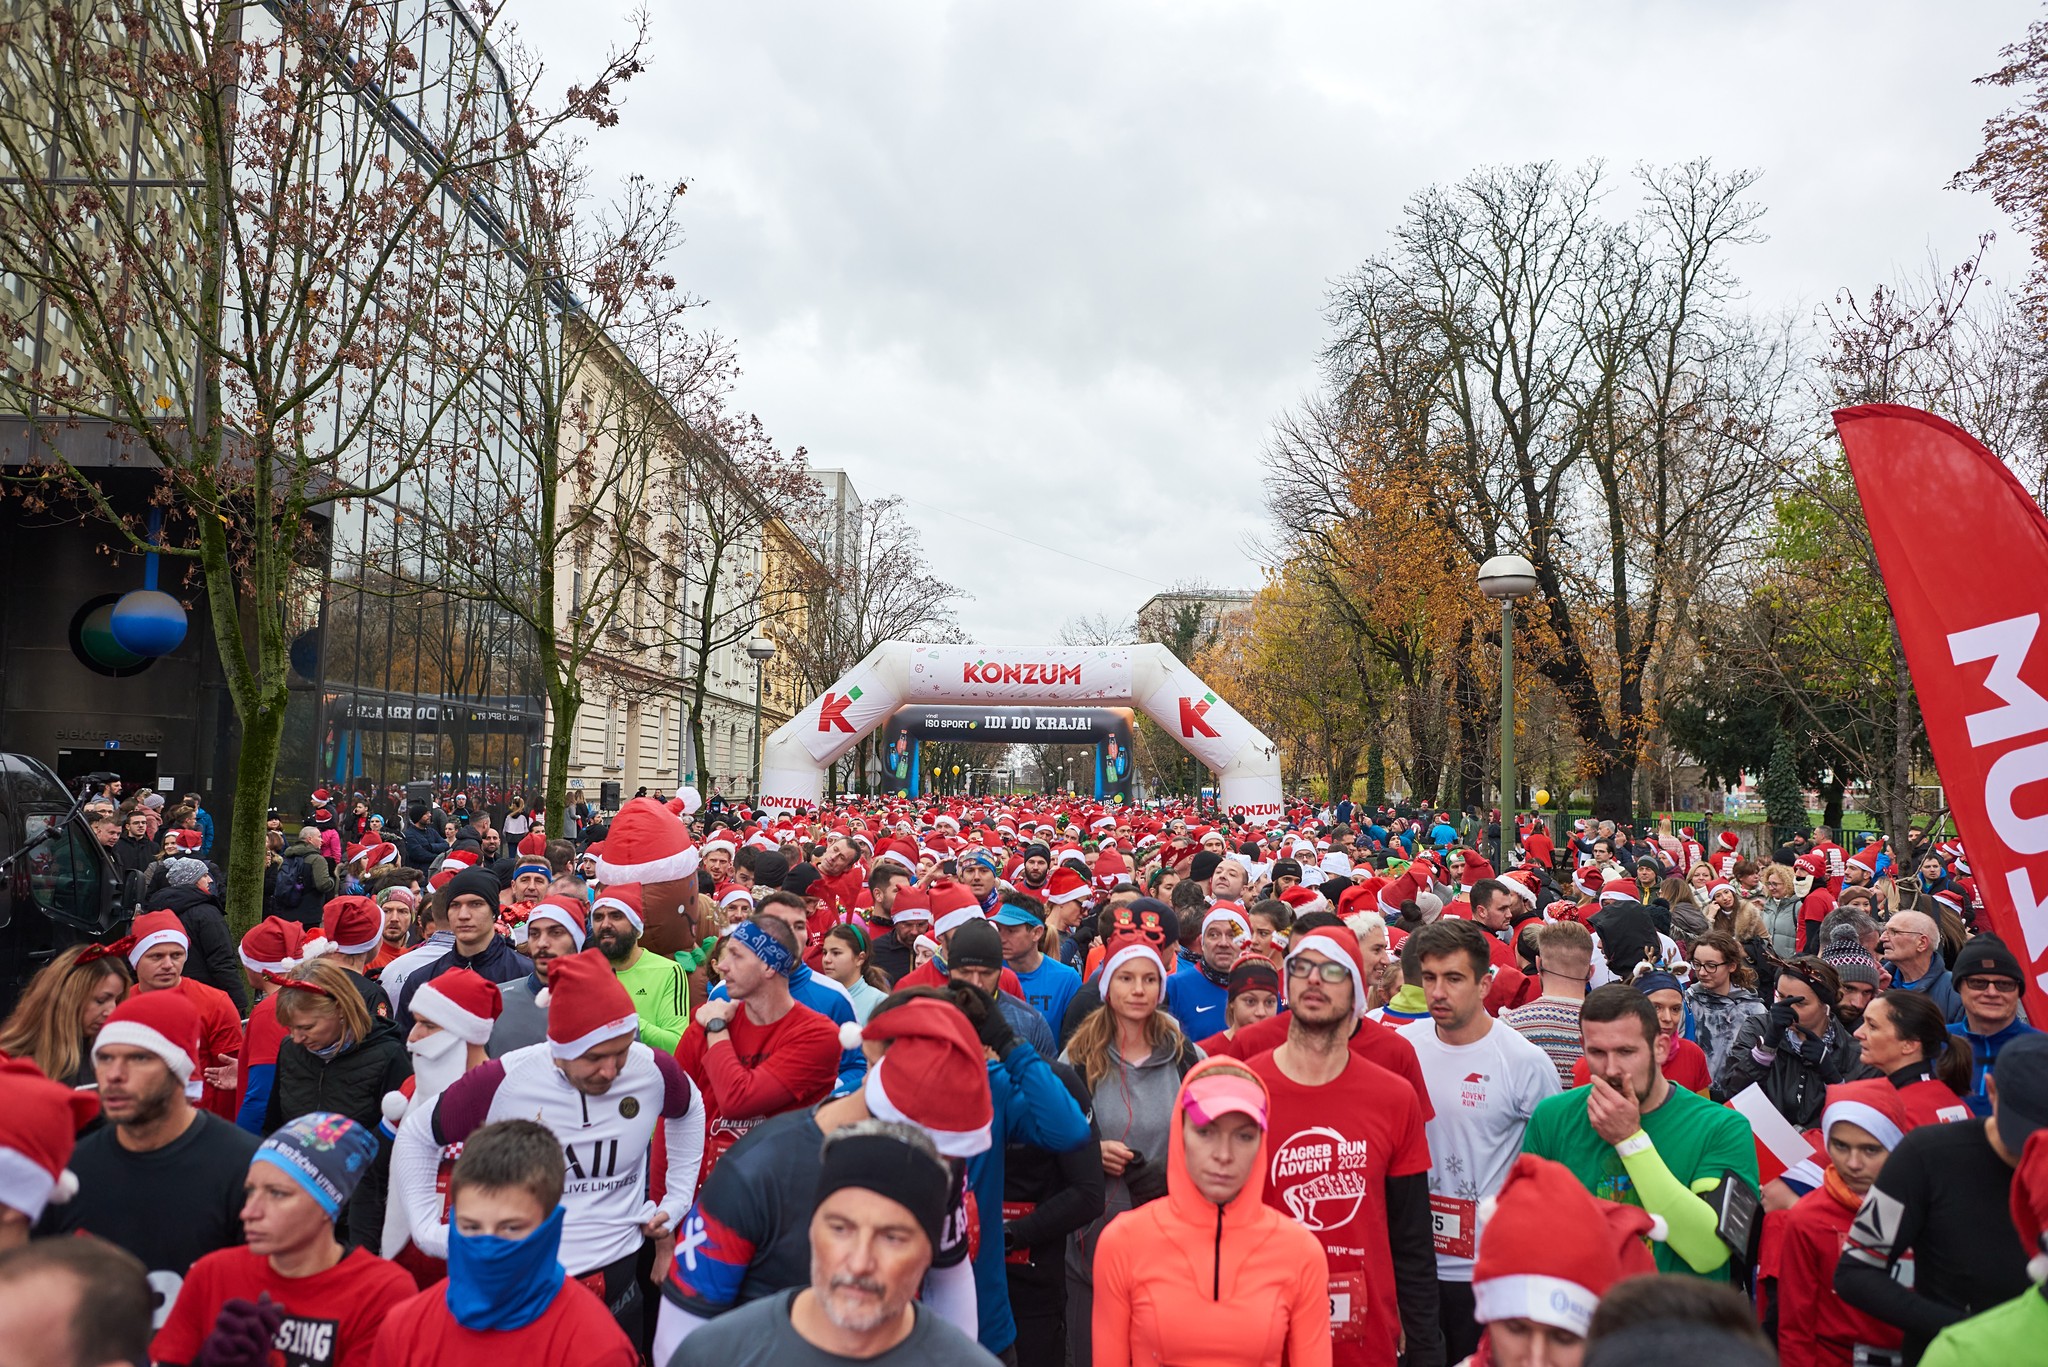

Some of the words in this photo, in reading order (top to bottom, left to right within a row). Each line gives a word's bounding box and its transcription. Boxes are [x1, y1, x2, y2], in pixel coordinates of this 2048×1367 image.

[963, 660, 1081, 685] KONZUM
[925, 720, 940, 728] ISO
[941, 720, 970, 729] SPORT
[984, 716, 1007, 729] IDI
[1011, 717, 1031, 730] DO
[1036, 717, 1091, 730] KRAJA!
[55, 727, 111, 740] elektra
[117, 729, 164, 745] zagreb
[760, 795, 812, 809] KONZUM
[1228, 803, 1281, 818] KONZUM
[1461, 1091, 1486, 1102] ADVENT
[1462, 1099, 1475, 1107] RUN
[1280, 1143, 1332, 1163] ZAGREB
[1337, 1140, 1367, 1157] RUN
[1278, 1157, 1332, 1178] ADVENT
[1337, 1153, 1367, 1170] 2022
[591, 1173, 638, 1193] LIMITLESS
